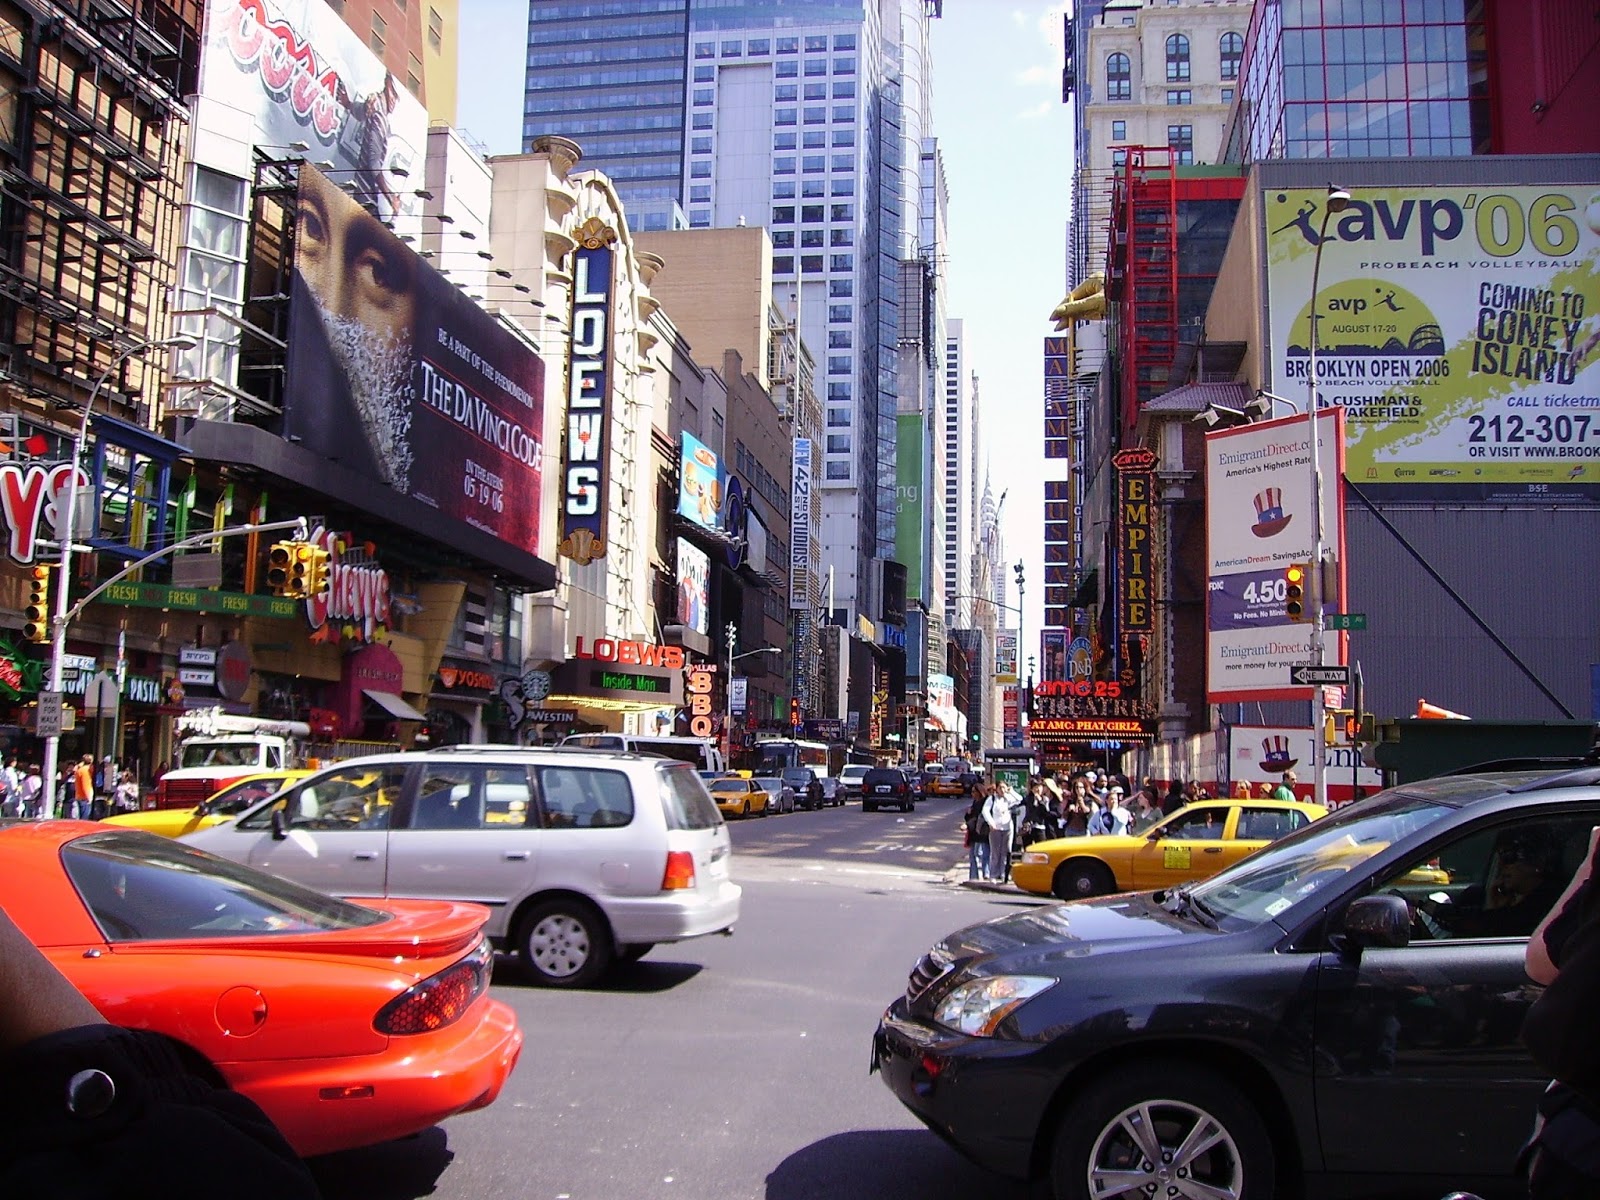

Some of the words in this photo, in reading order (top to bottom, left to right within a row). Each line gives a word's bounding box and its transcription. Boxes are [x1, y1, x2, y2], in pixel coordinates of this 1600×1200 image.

[1337, 199, 1464, 256] avp
[1468, 260, 1583, 268] VOLLEYBALL
[1328, 298, 1367, 315] avp
[1480, 281, 1555, 315] COMING
[1561, 292, 1585, 319] TO
[1332, 325, 1370, 333] AUGUST
[1373, 324, 1397, 333] 17-20
[1477, 307, 1582, 352] CONEY
[438, 327, 448, 346] BE
[448, 336, 455, 351] A
[454, 340, 472, 363] PART
[471, 352, 482, 370] OF
[481, 359, 494, 381] THE
[494, 370, 534, 410] PHENOMENON
[1371, 360, 1410, 378] OPEN
[1415, 359, 1450, 377] 2006
[1472, 340, 1577, 385] ISLAND
[567, 256, 606, 516] LOEWS
[1333, 395, 1411, 406] CUSHMAN
[1412, 395, 1422, 406] &
[1507, 396, 1539, 407] CALL
[1544, 394, 1600, 407] ticketm
[421, 361, 452, 415] THE
[511, 424, 543, 472] CODE
[794, 439, 810, 467] NEW
[1469, 446, 1486, 457] OR
[1489, 446, 1520, 457] VISIT
[1225, 463, 1262, 478] America's
[1263, 458, 1293, 472] Highest
[1294, 456, 1311, 466] Rate
[793, 511, 808, 565] STUDIOS
[1125, 478, 1148, 625] EMPIRE
[106, 585, 138, 600] FRESH
[1208, 581, 1224, 591] FDIC
[1243, 578, 1287, 604] 4.50
[168, 590, 197, 606] FRESH
[223, 596, 248, 610] FRESH
[270, 601, 294, 614] FRESH
[1342, 617, 1350, 628] 8
[186, 652, 210, 661] NYPD
[576, 635, 685, 670] LOEWS
[1220, 642, 1325, 659] EmigrantDirect.c
[1244, 661, 1266, 670] money
[1267, 660, 1277, 668] for
[1278, 660, 1294, 669] your
[602, 672, 632, 690] Inside
[1300, 672, 1317, 680] ONE
[1324, 672, 1342, 680] WAY
[130, 678, 160, 703] PASTA
[1034, 680, 1092, 697] amc
[1095, 681, 1121, 697] 25
[691, 672, 712, 737] BBQ
[535, 711, 574, 721] WESTIN
[1031, 721, 1046, 730] AT
[1047, 721, 1074, 730] AMC:
[1077, 721, 1107, 730] PHAT
[1107, 721, 1142, 732] GIRLZ,
